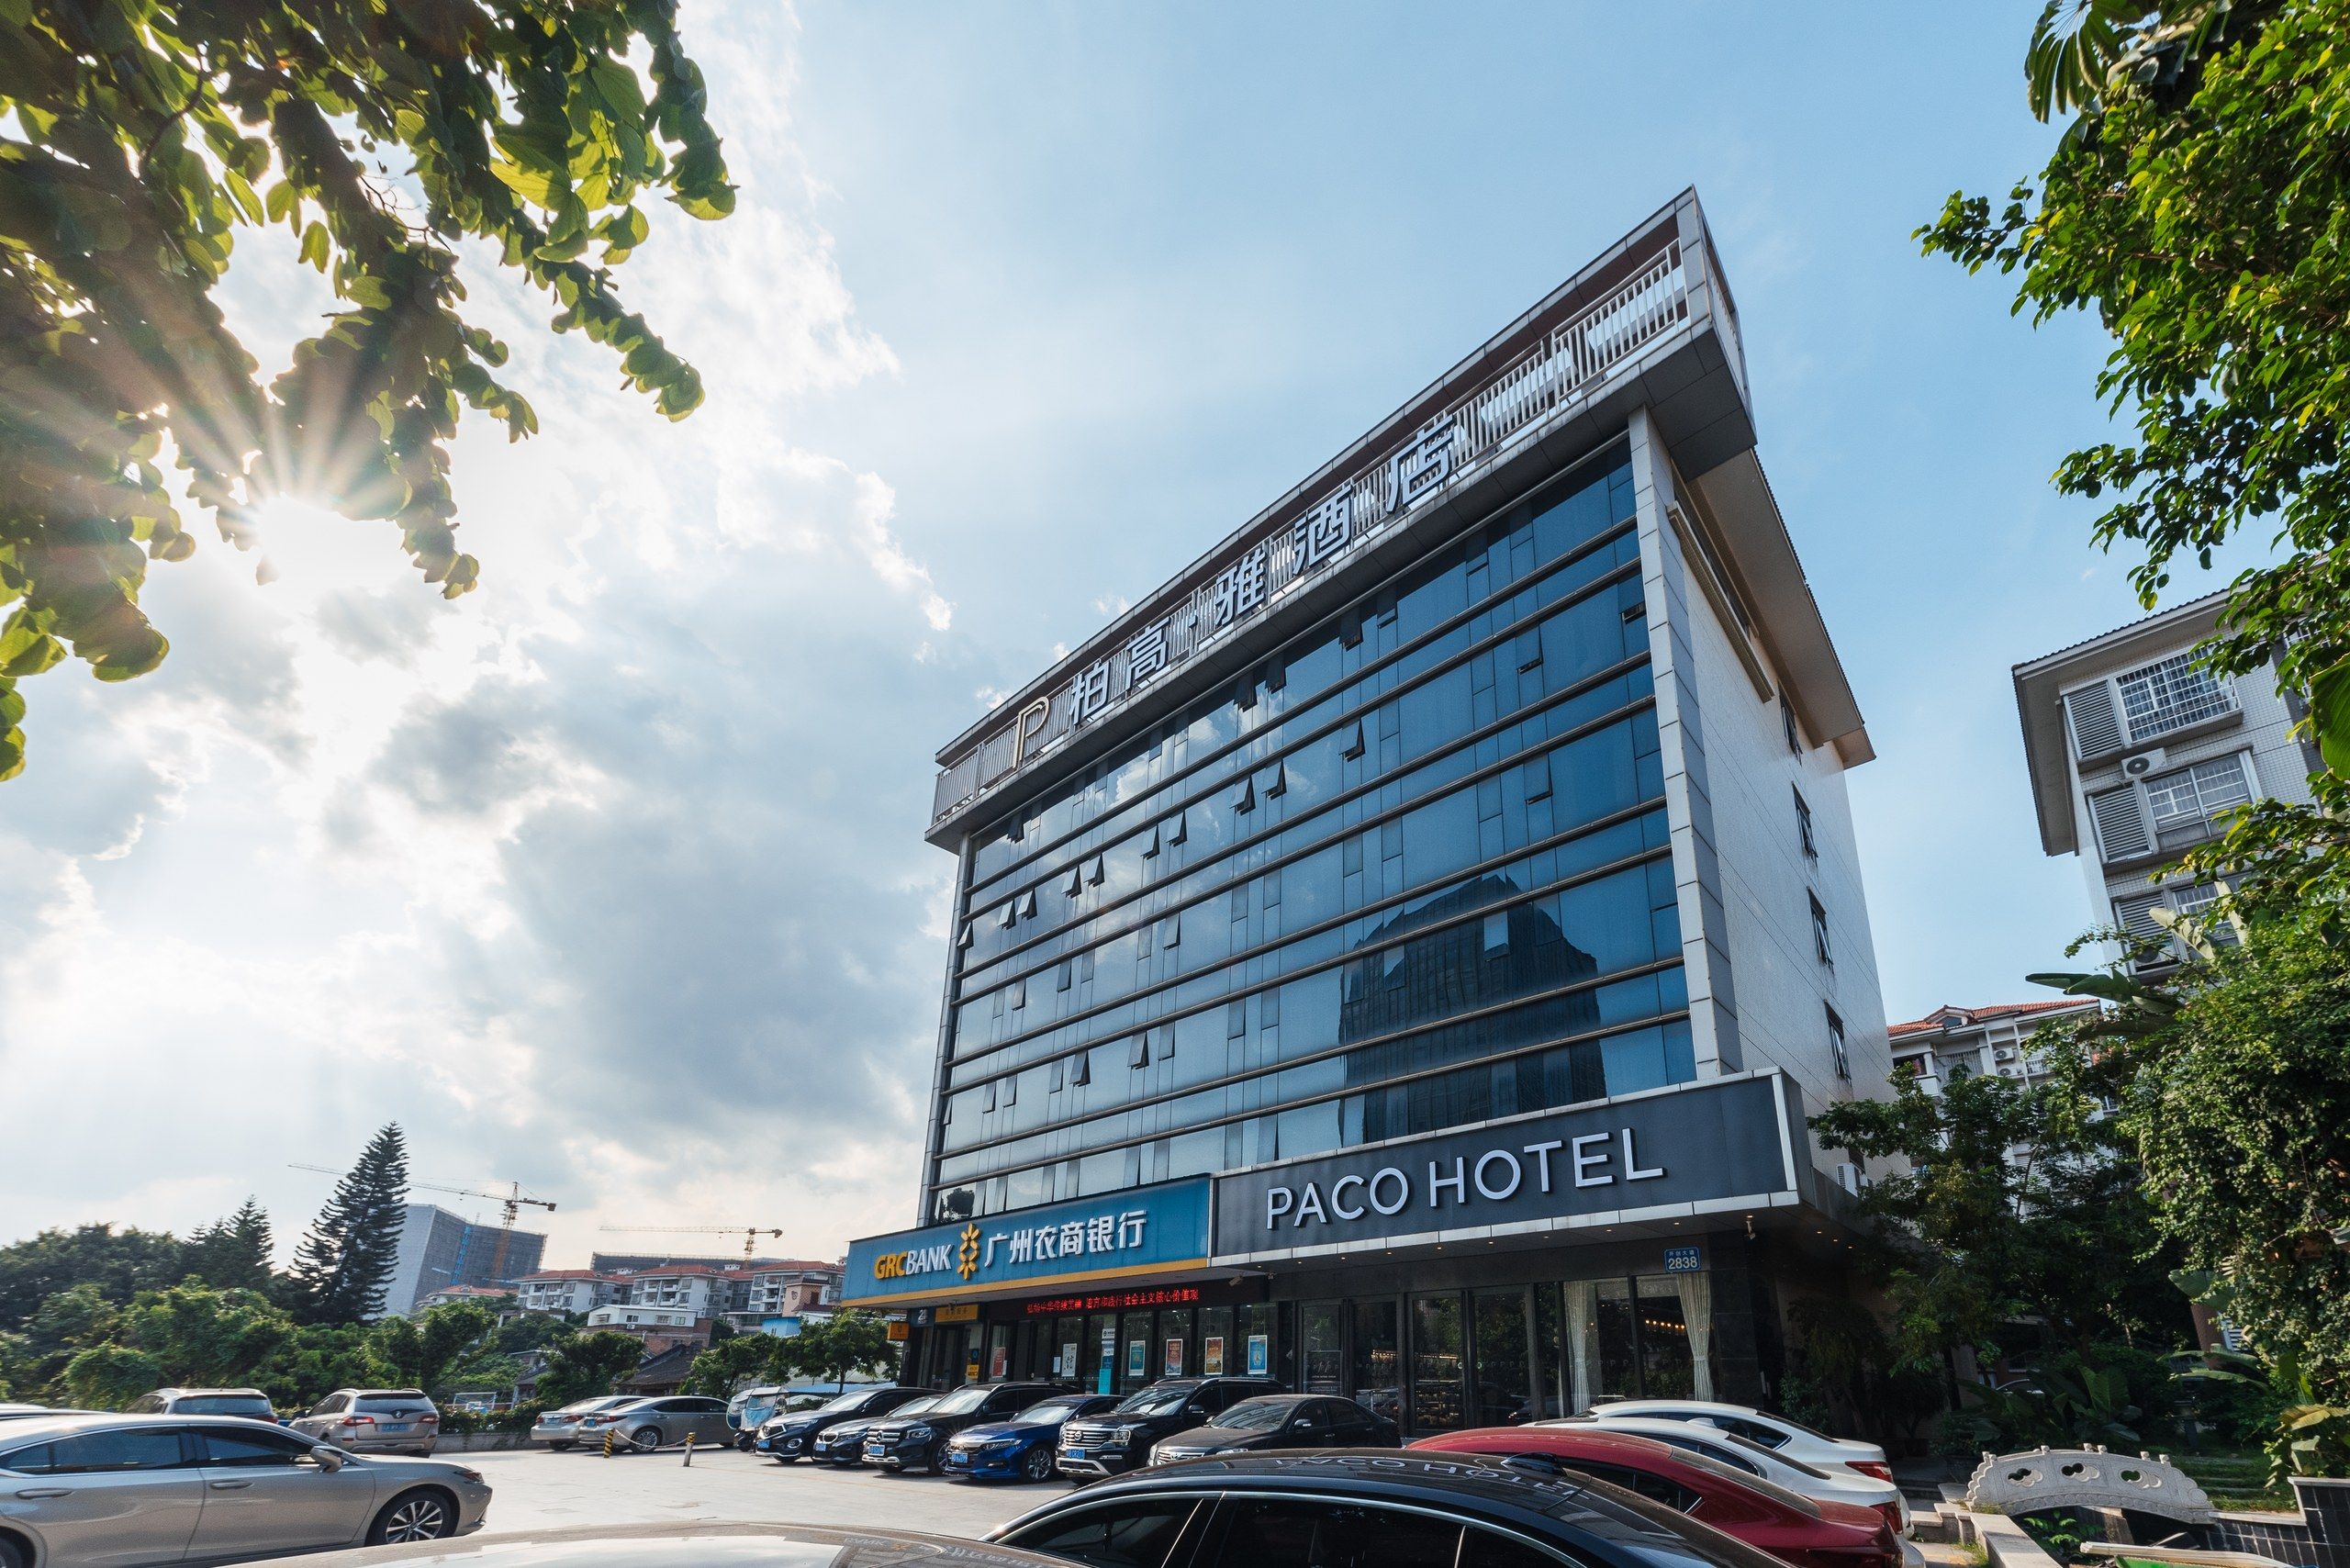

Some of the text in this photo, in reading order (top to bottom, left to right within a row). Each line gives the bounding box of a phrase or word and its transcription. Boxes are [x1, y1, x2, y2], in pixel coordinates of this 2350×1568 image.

[1267, 1127, 1665, 1230] PACO HOTEL
[874, 1210, 1146, 1280] GRCBANK 广州农商银行
[1668, 1256, 1697, 1270] 2838
